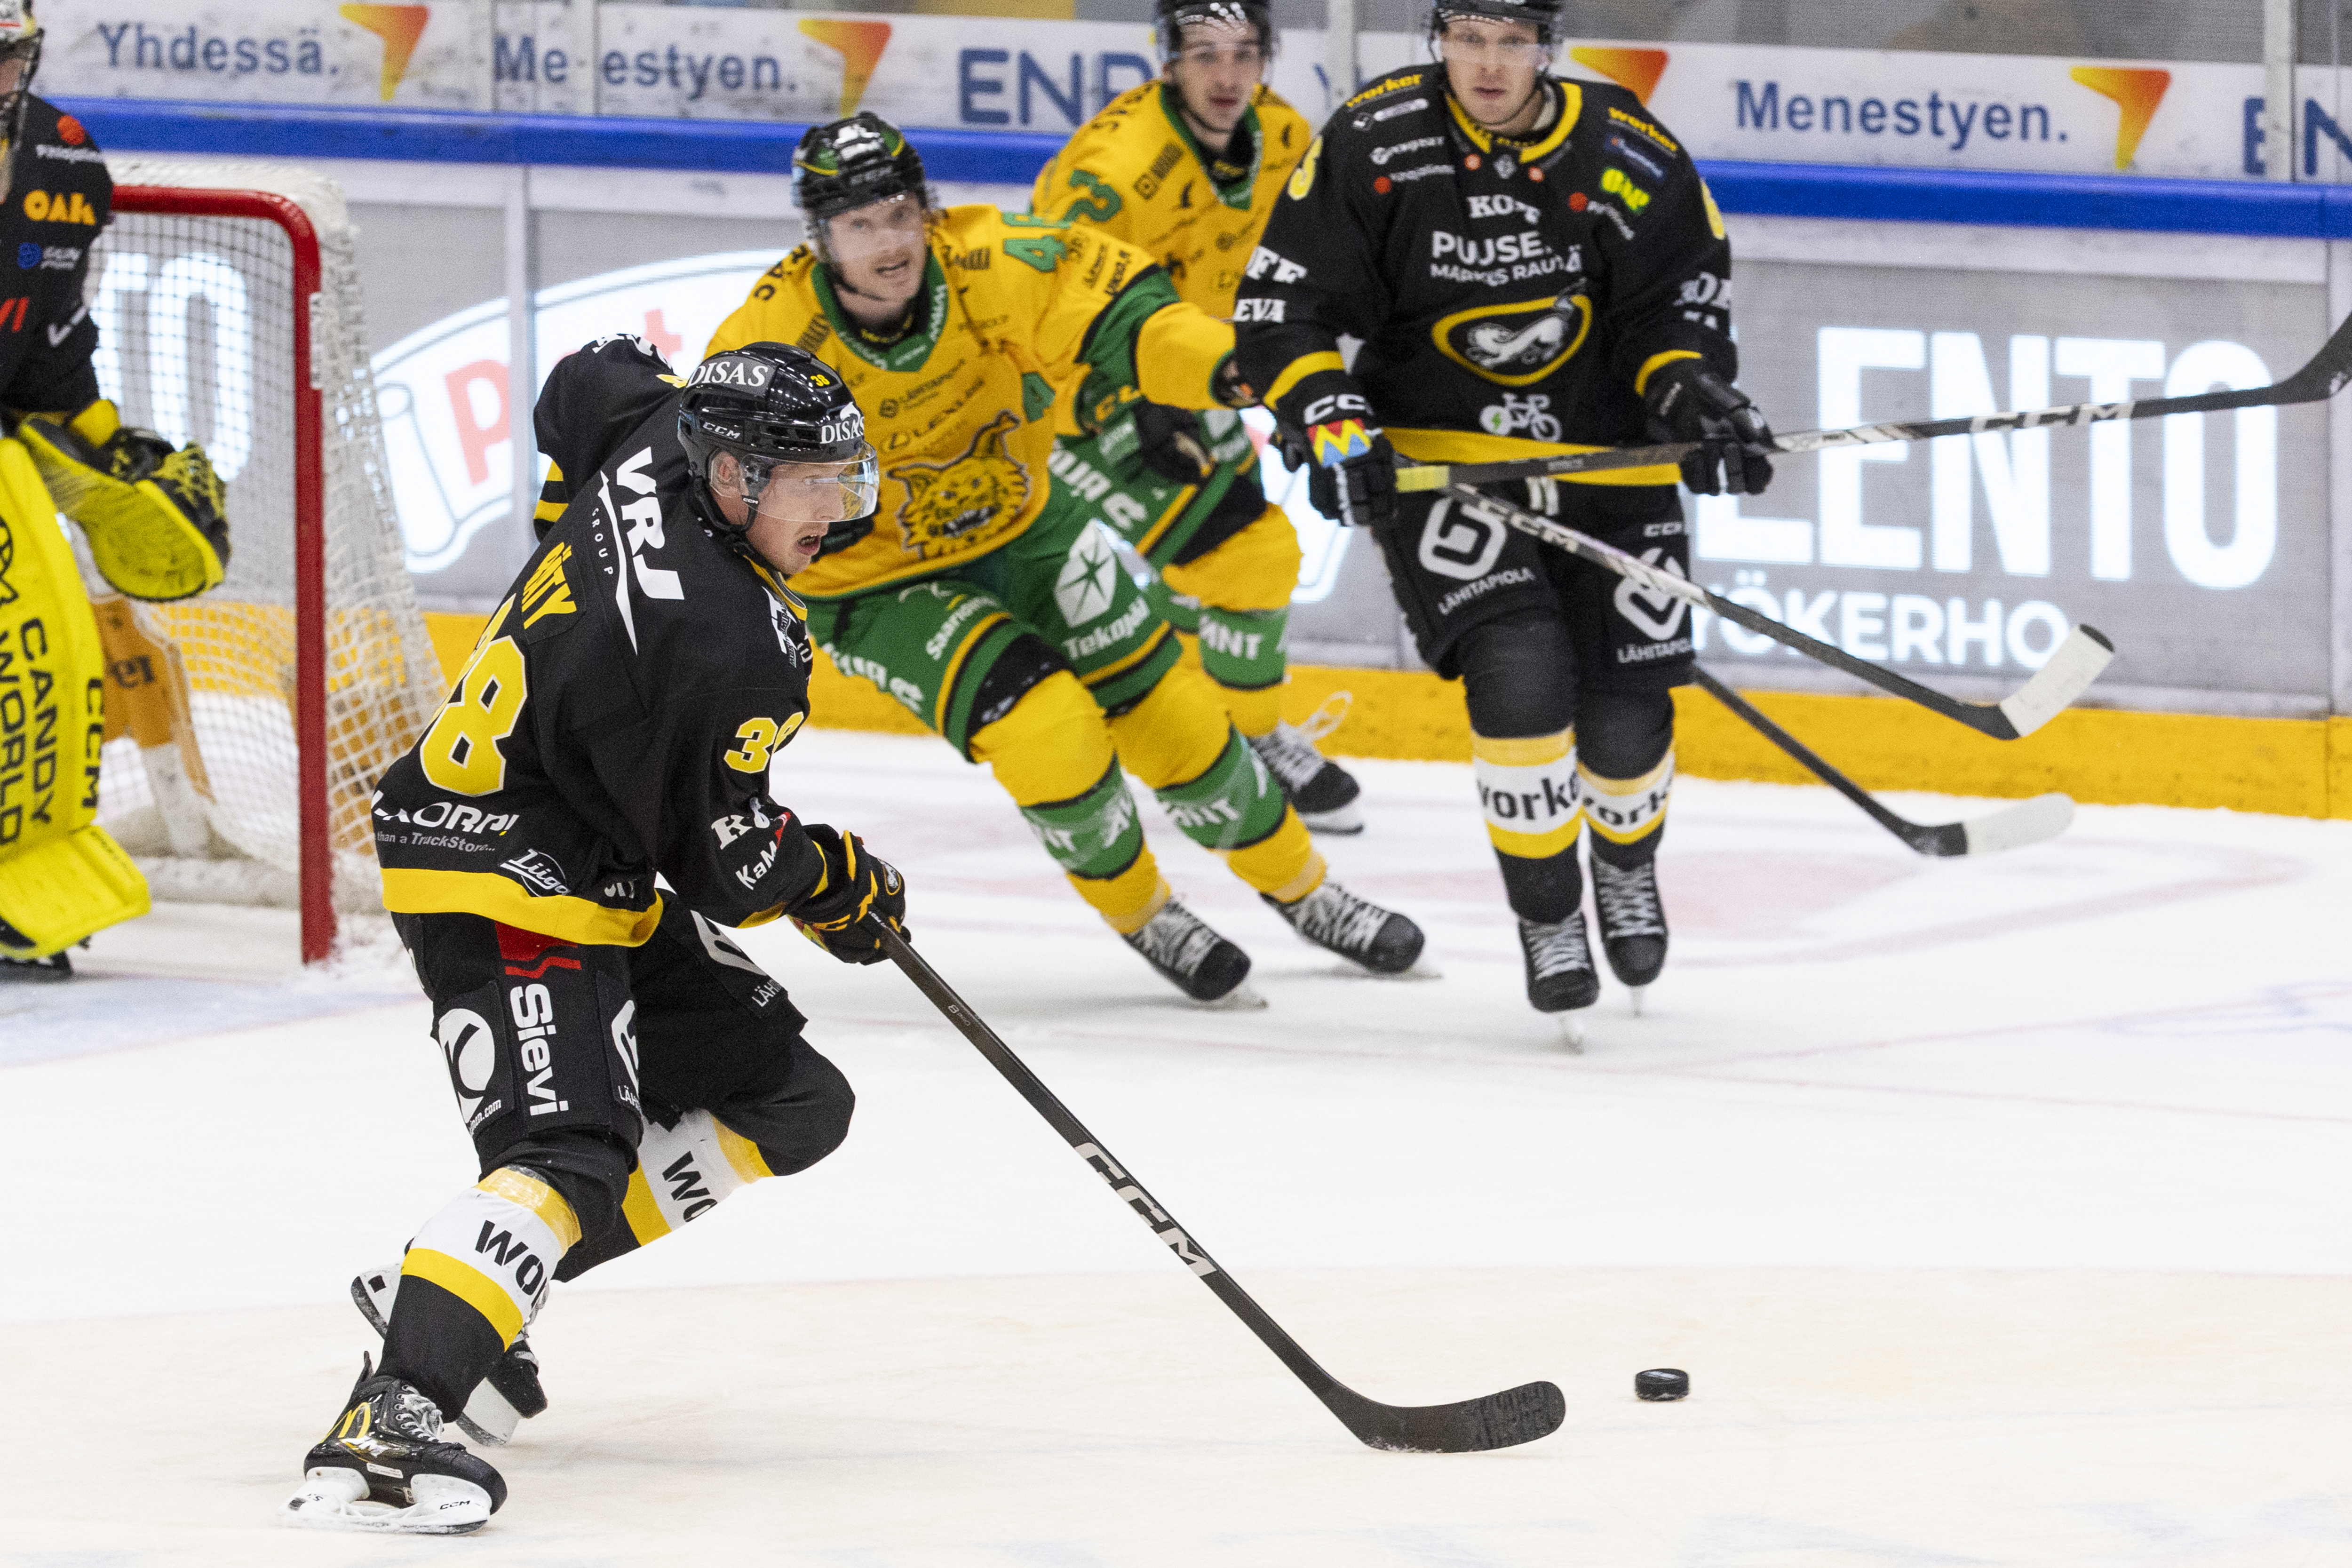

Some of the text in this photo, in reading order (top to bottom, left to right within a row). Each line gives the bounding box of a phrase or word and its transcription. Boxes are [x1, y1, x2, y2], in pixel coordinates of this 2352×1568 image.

[98, 23, 338, 75] Yhdessä.
[494, 35, 796, 100] Meestyen.
[1736, 80, 2069, 151] Menestyen.
[686, 361, 769, 388] DISAS
[810, 374, 830, 386] 38
[702, 422, 740, 439] CCM
[592, 508, 614, 575] GROUP
[20, 617, 58, 825] CANDY
[82, 677, 105, 810] CCM
[510, 983, 569, 1116] Sievi
[1074, 1142, 1218, 1277] CCM
[440, 1500, 470, 1510] CCM
